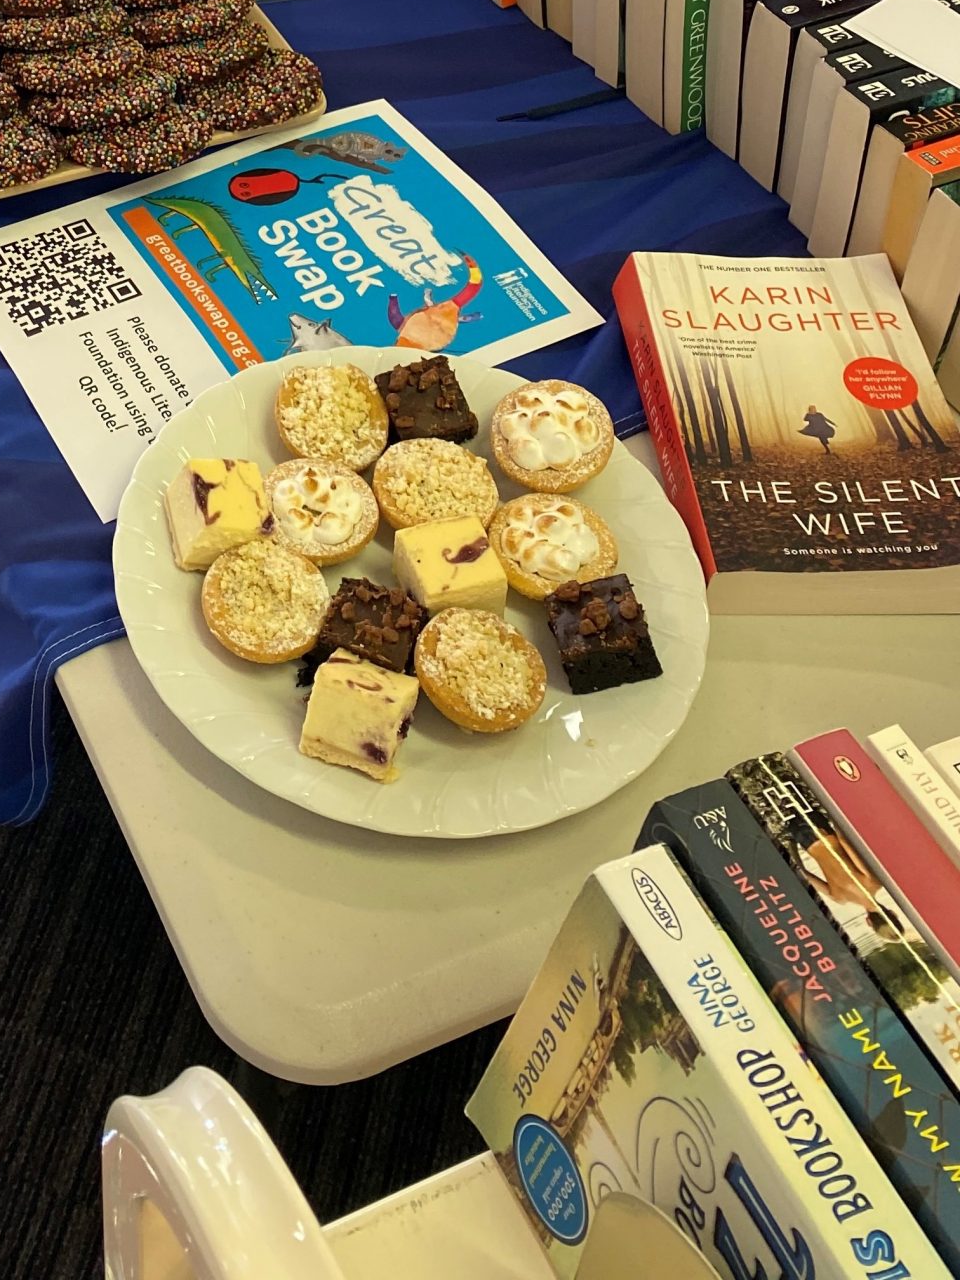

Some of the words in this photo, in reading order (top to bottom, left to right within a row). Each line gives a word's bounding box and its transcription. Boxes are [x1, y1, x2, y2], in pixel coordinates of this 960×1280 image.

[686, 9, 707, 131] GREENWOOD
[295, 207, 386, 297] Book
[341, 185, 439, 276] Great
[258, 220, 346, 310] Swap
[698, 264, 715, 272] THE
[716, 264, 752, 273] NUMBER
[753, 265, 772, 273] ONE
[709, 286, 834, 306] KARIN
[145, 234, 259, 368] greatbookswap.org.a
[662, 310, 903, 332] SLAUGHTER
[106, 328, 156, 394] Indigenous
[126, 316, 158, 354] Please
[154, 355, 189, 399] donate
[683, 343, 715, 352] novelists
[692, 350, 734, 360] Washington
[735, 352, 753, 360] Post
[78, 375, 99, 397] QR
[91, 397, 129, 433] code!
[79, 331, 129, 400] Foundation
[124, 401, 153, 437] using
[862, 384, 902, 393] GILLIAN
[869, 392, 902, 401] FLYNN
[632, 339, 644, 374] THE
[643, 378, 664, 445] SILENT
[662, 447, 678, 499] WIFE
[711, 480, 797, 504] THE
[814, 477, 960, 504] SILENT
[792, 511, 909, 536] WIFE
[783, 546, 838, 556] Someone
[842, 546, 853, 555] is
[856, 544, 911, 557] watching
[916, 542, 938, 554] you
[693, 805, 728, 830] A&U
[635, 874, 679, 931] ABACUS
[724, 863, 833, 1004] JACQUELINE
[758, 874, 837, 974] BUBLITZ
[553, 969, 589, 1036] NINA
[685, 972, 726, 1030] NINA
[692, 952, 757, 1034] GEORGE
[512, 1030, 559, 1108] GEORGE
[838, 1008, 912, 1098] NAME
[904, 1106, 951, 1154] MY
[735, 1048, 875, 1224] BOOKSHOP
[547, 1171, 576, 1221] 500,000
